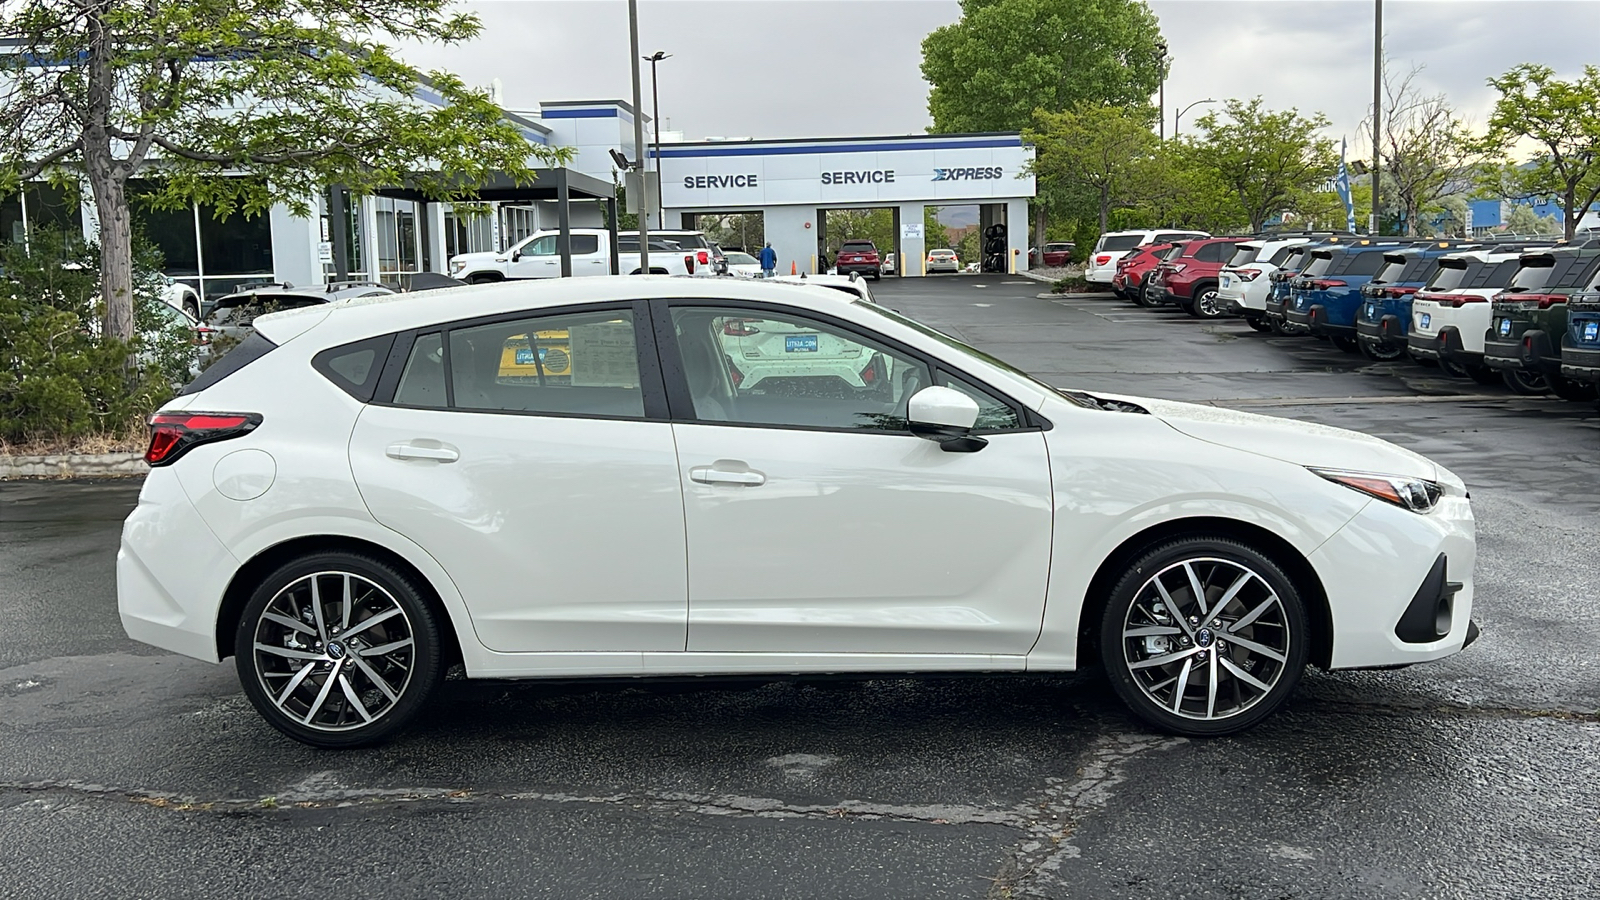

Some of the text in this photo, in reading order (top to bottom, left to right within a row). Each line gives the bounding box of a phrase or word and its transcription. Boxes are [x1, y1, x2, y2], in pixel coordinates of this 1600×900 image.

[821, 170, 895, 184] SERVICE
[931, 167, 1003, 181] EXPRESS
[684, 175, 758, 189] SERVICE
